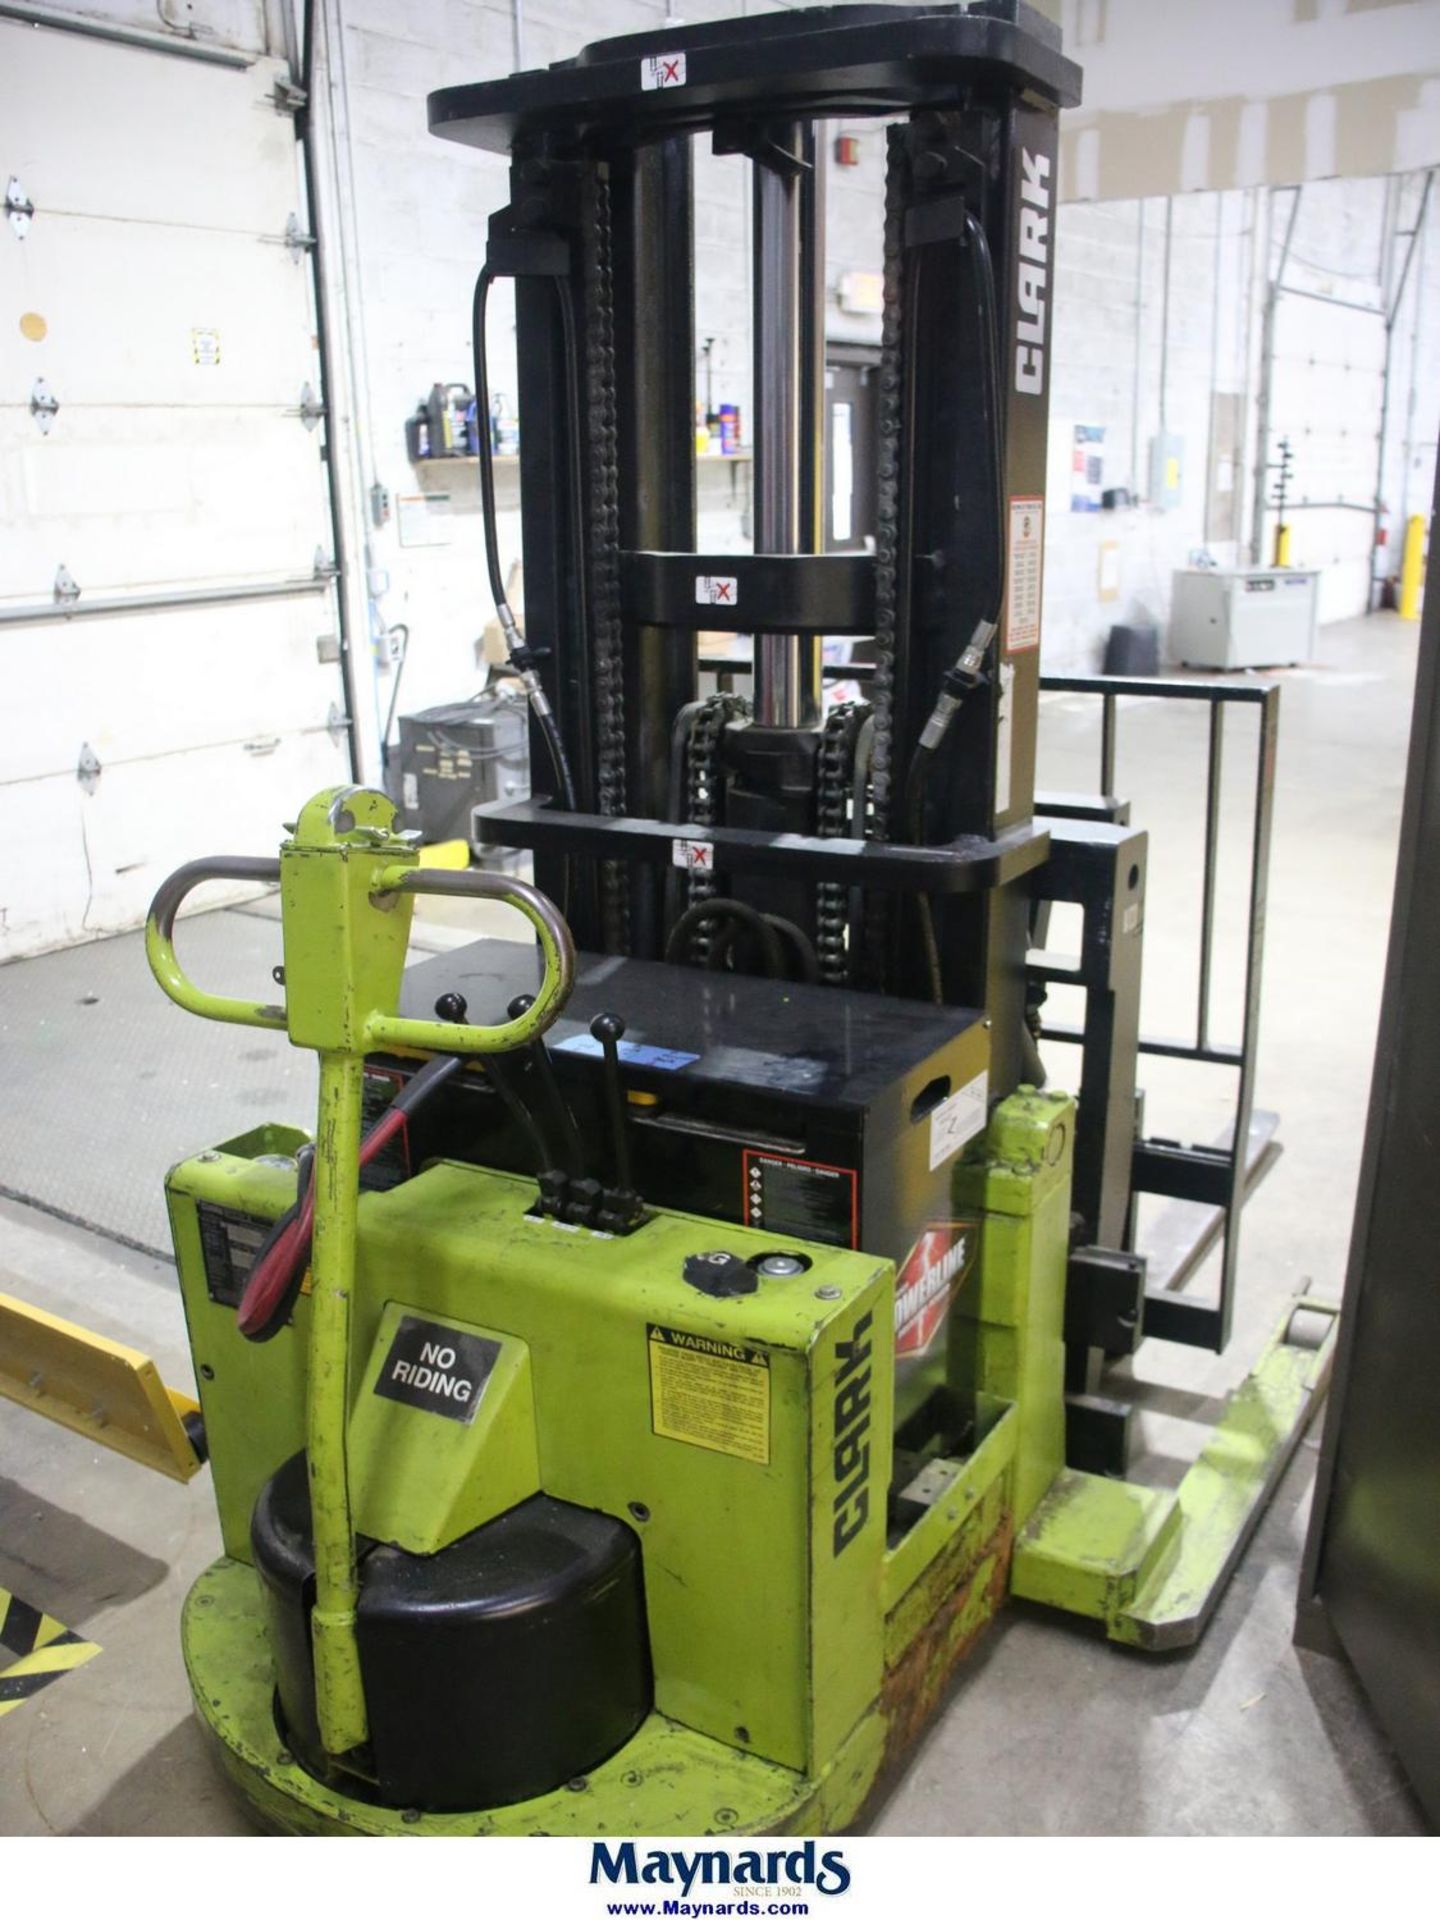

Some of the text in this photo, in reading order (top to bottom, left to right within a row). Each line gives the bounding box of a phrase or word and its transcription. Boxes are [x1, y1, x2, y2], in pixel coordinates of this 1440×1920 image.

[1016, 147, 1050, 395] CLARK
[895, 1236, 966, 1333] OWERLINE
[420, 1342, 456, 1369] NO
[671, 1331, 747, 1361] WARNING
[391, 1360, 472, 1402] RIDING
[834, 1310, 873, 1558] CLARK
